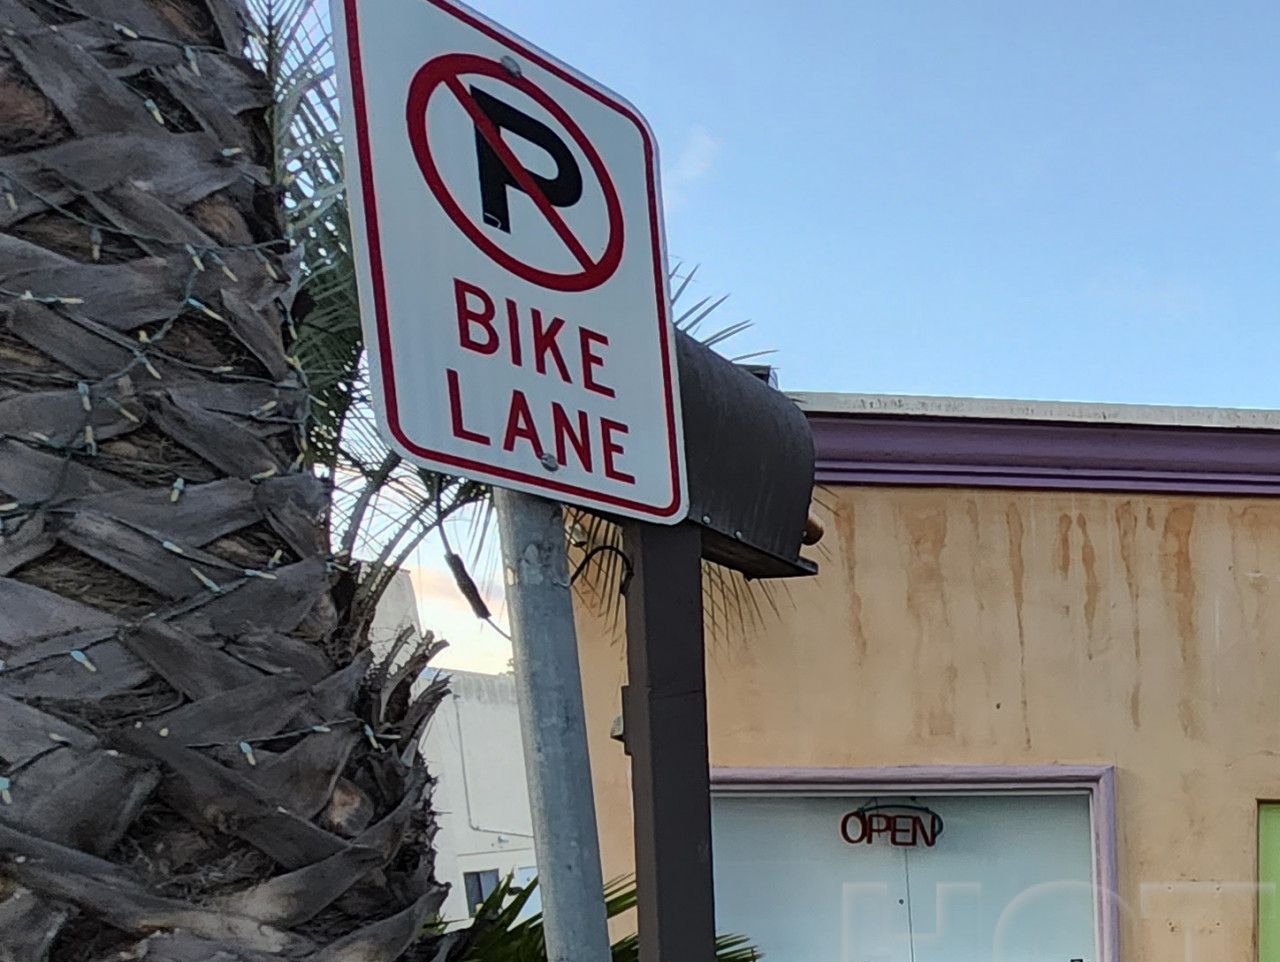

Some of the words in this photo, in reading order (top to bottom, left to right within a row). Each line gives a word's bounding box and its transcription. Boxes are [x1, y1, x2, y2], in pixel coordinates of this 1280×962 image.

[453, 277, 616, 399] BIKE
[445, 368, 636, 485] LANE
[840, 809, 937, 847] OPEN
